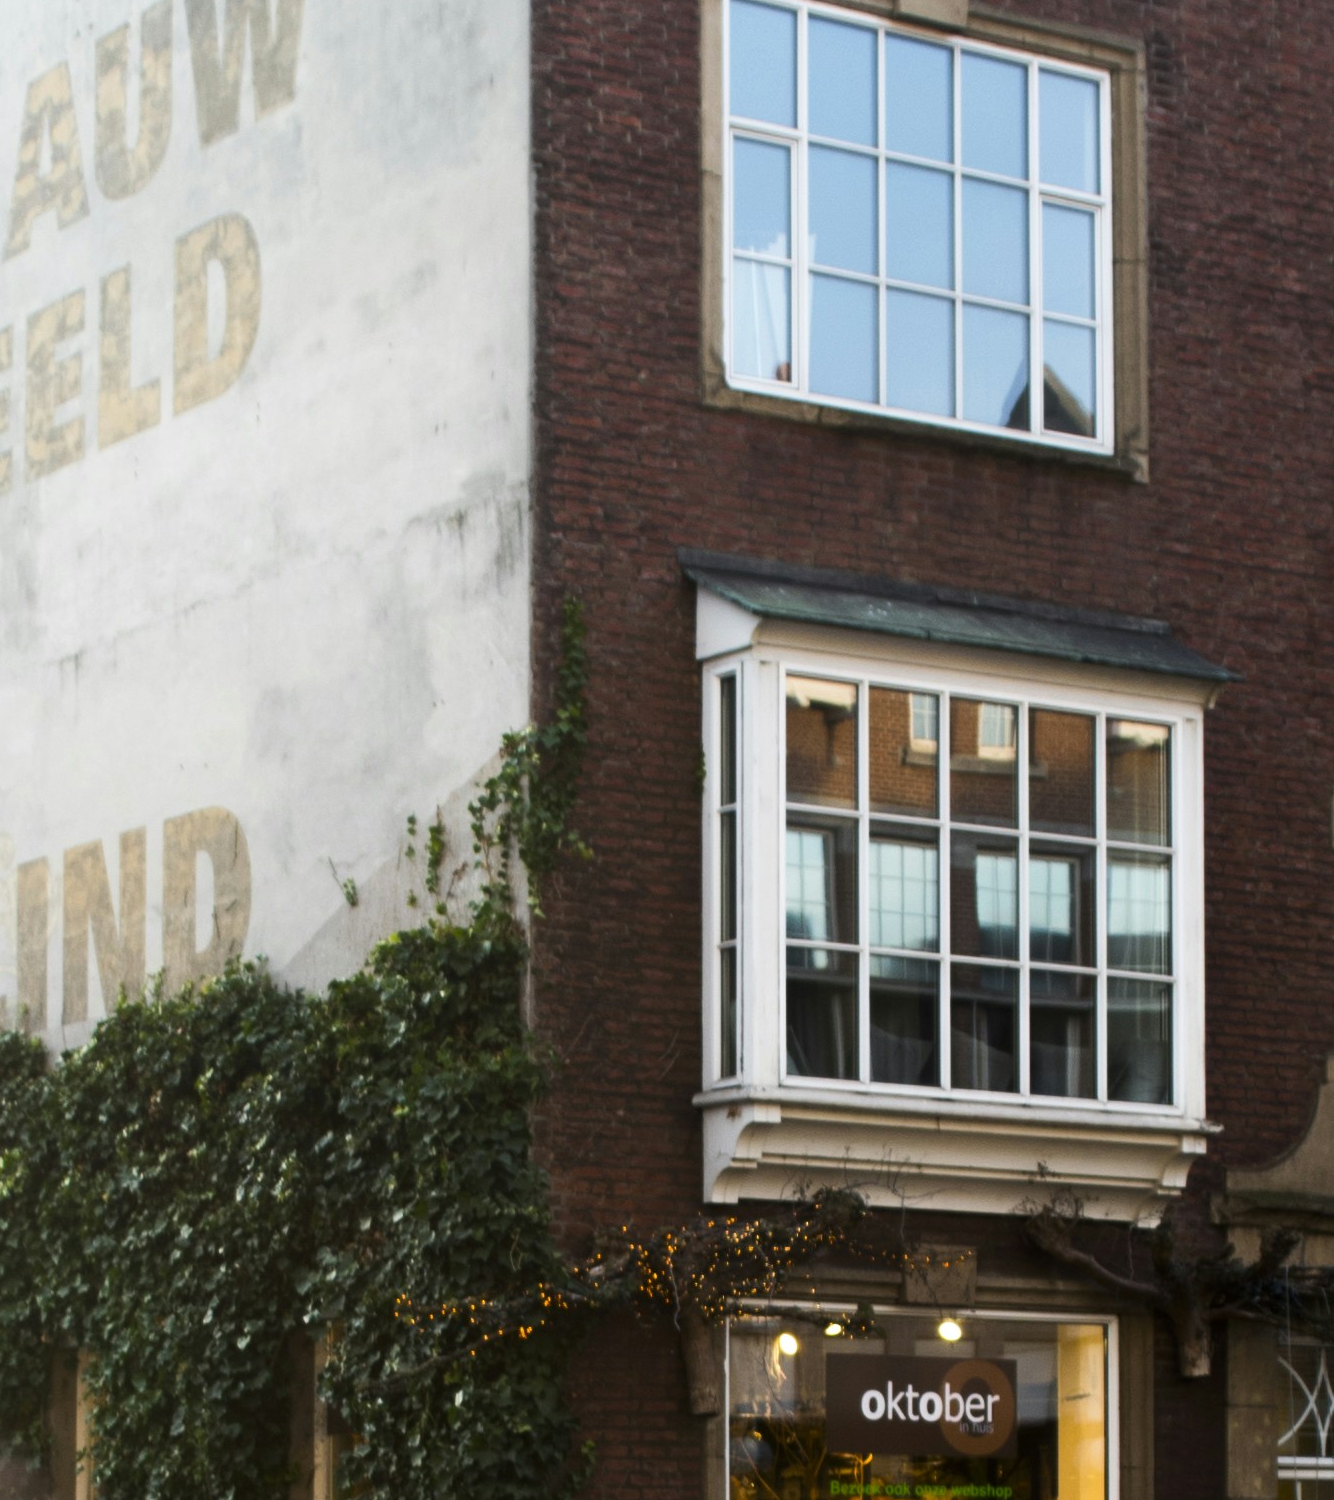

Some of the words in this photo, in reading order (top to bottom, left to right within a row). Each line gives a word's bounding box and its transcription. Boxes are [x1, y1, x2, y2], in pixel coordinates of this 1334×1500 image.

[860, 1379, 1001, 1423] oktober
[829, 1479, 881, 1496] Bezoek
[885, 1481, 911, 1496] ook
[915, 1484, 949, 1498] onze
[950, 1481, 1013, 1500] webshop
